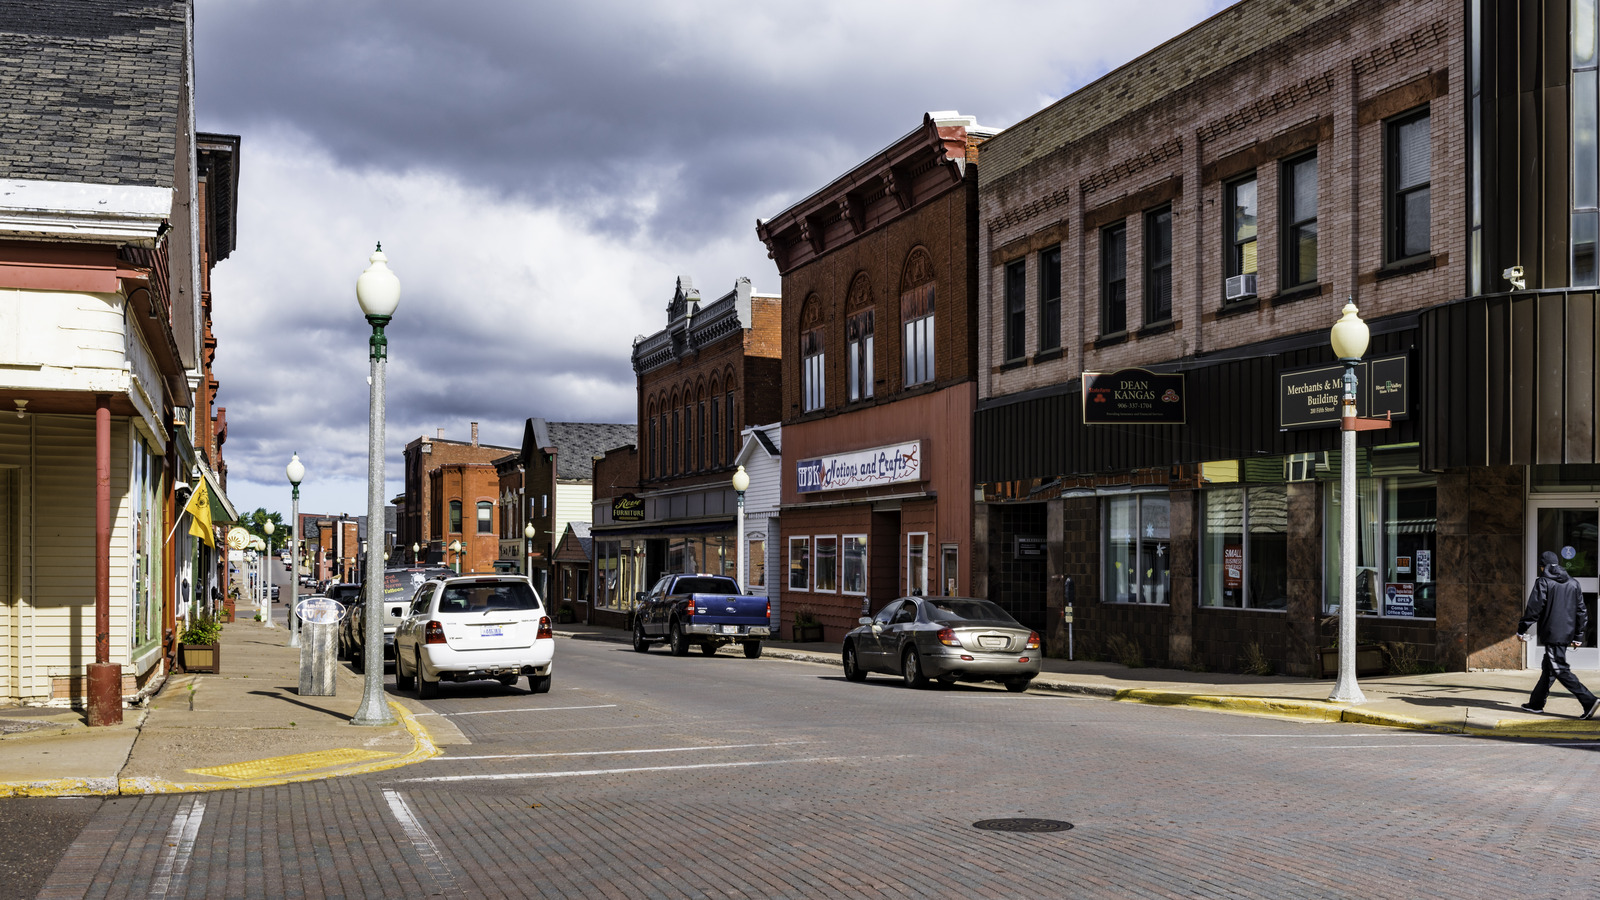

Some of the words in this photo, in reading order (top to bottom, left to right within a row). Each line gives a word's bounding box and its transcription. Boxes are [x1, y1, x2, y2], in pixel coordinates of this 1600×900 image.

[1120, 380, 1148, 390] DEAN
[1287, 382, 1322, 395] Merchants
[1324, 380, 1331, 390] &
[1114, 390, 1155, 400] KANGAS
[1307, 394, 1338, 405] Building
[798, 465, 820, 486] WBK
[826, 460, 857, 485] Notions
[860, 454, 876, 475] and
[879, 449, 906, 480] Crafts
[1225, 549, 1242, 557] SMALL
